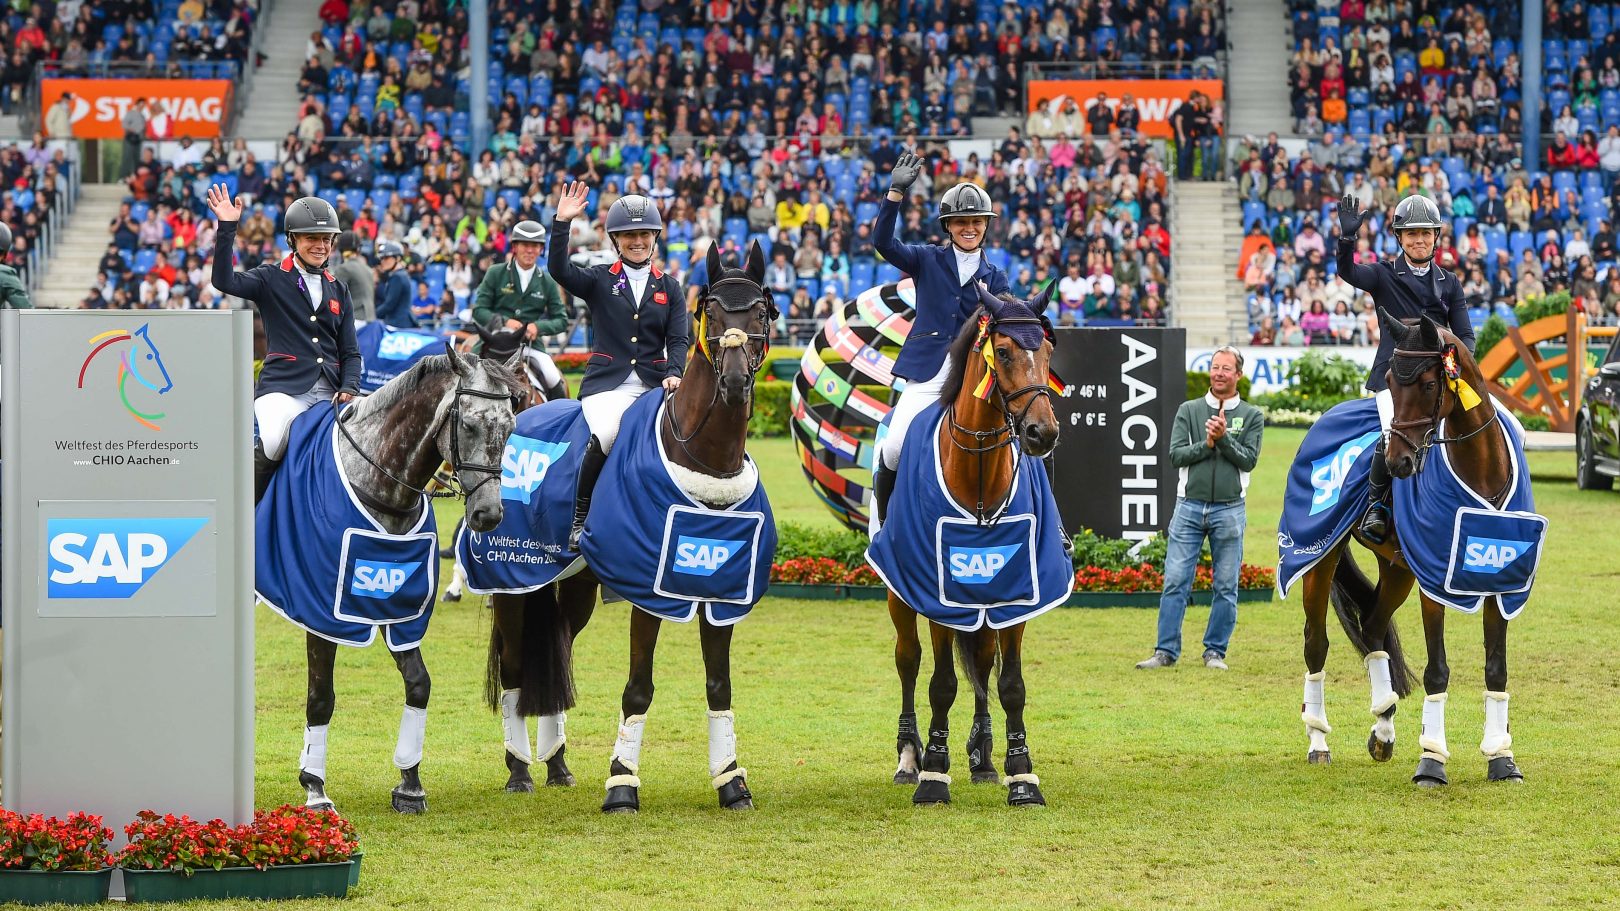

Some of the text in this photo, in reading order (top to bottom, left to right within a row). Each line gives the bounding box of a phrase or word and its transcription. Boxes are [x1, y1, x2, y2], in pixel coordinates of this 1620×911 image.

[381, 334, 422, 356] SAP
[1097, 384, 1107, 398] N
[1070, 412, 1082, 426] 6°
[1097, 412, 1107, 426] E
[55, 440, 199, 452] Weltfest des Pferdesports
[501, 444, 551, 493] SAP
[1311, 445, 1363, 505] SAP
[49, 532, 168, 585] SAP
[508, 551, 544, 564] Aachen
[675, 542, 729, 570] SAP
[950, 552, 1005, 578] SAP
[1464, 542, 1517, 568] SAP
[353, 566, 406, 593] SAP
